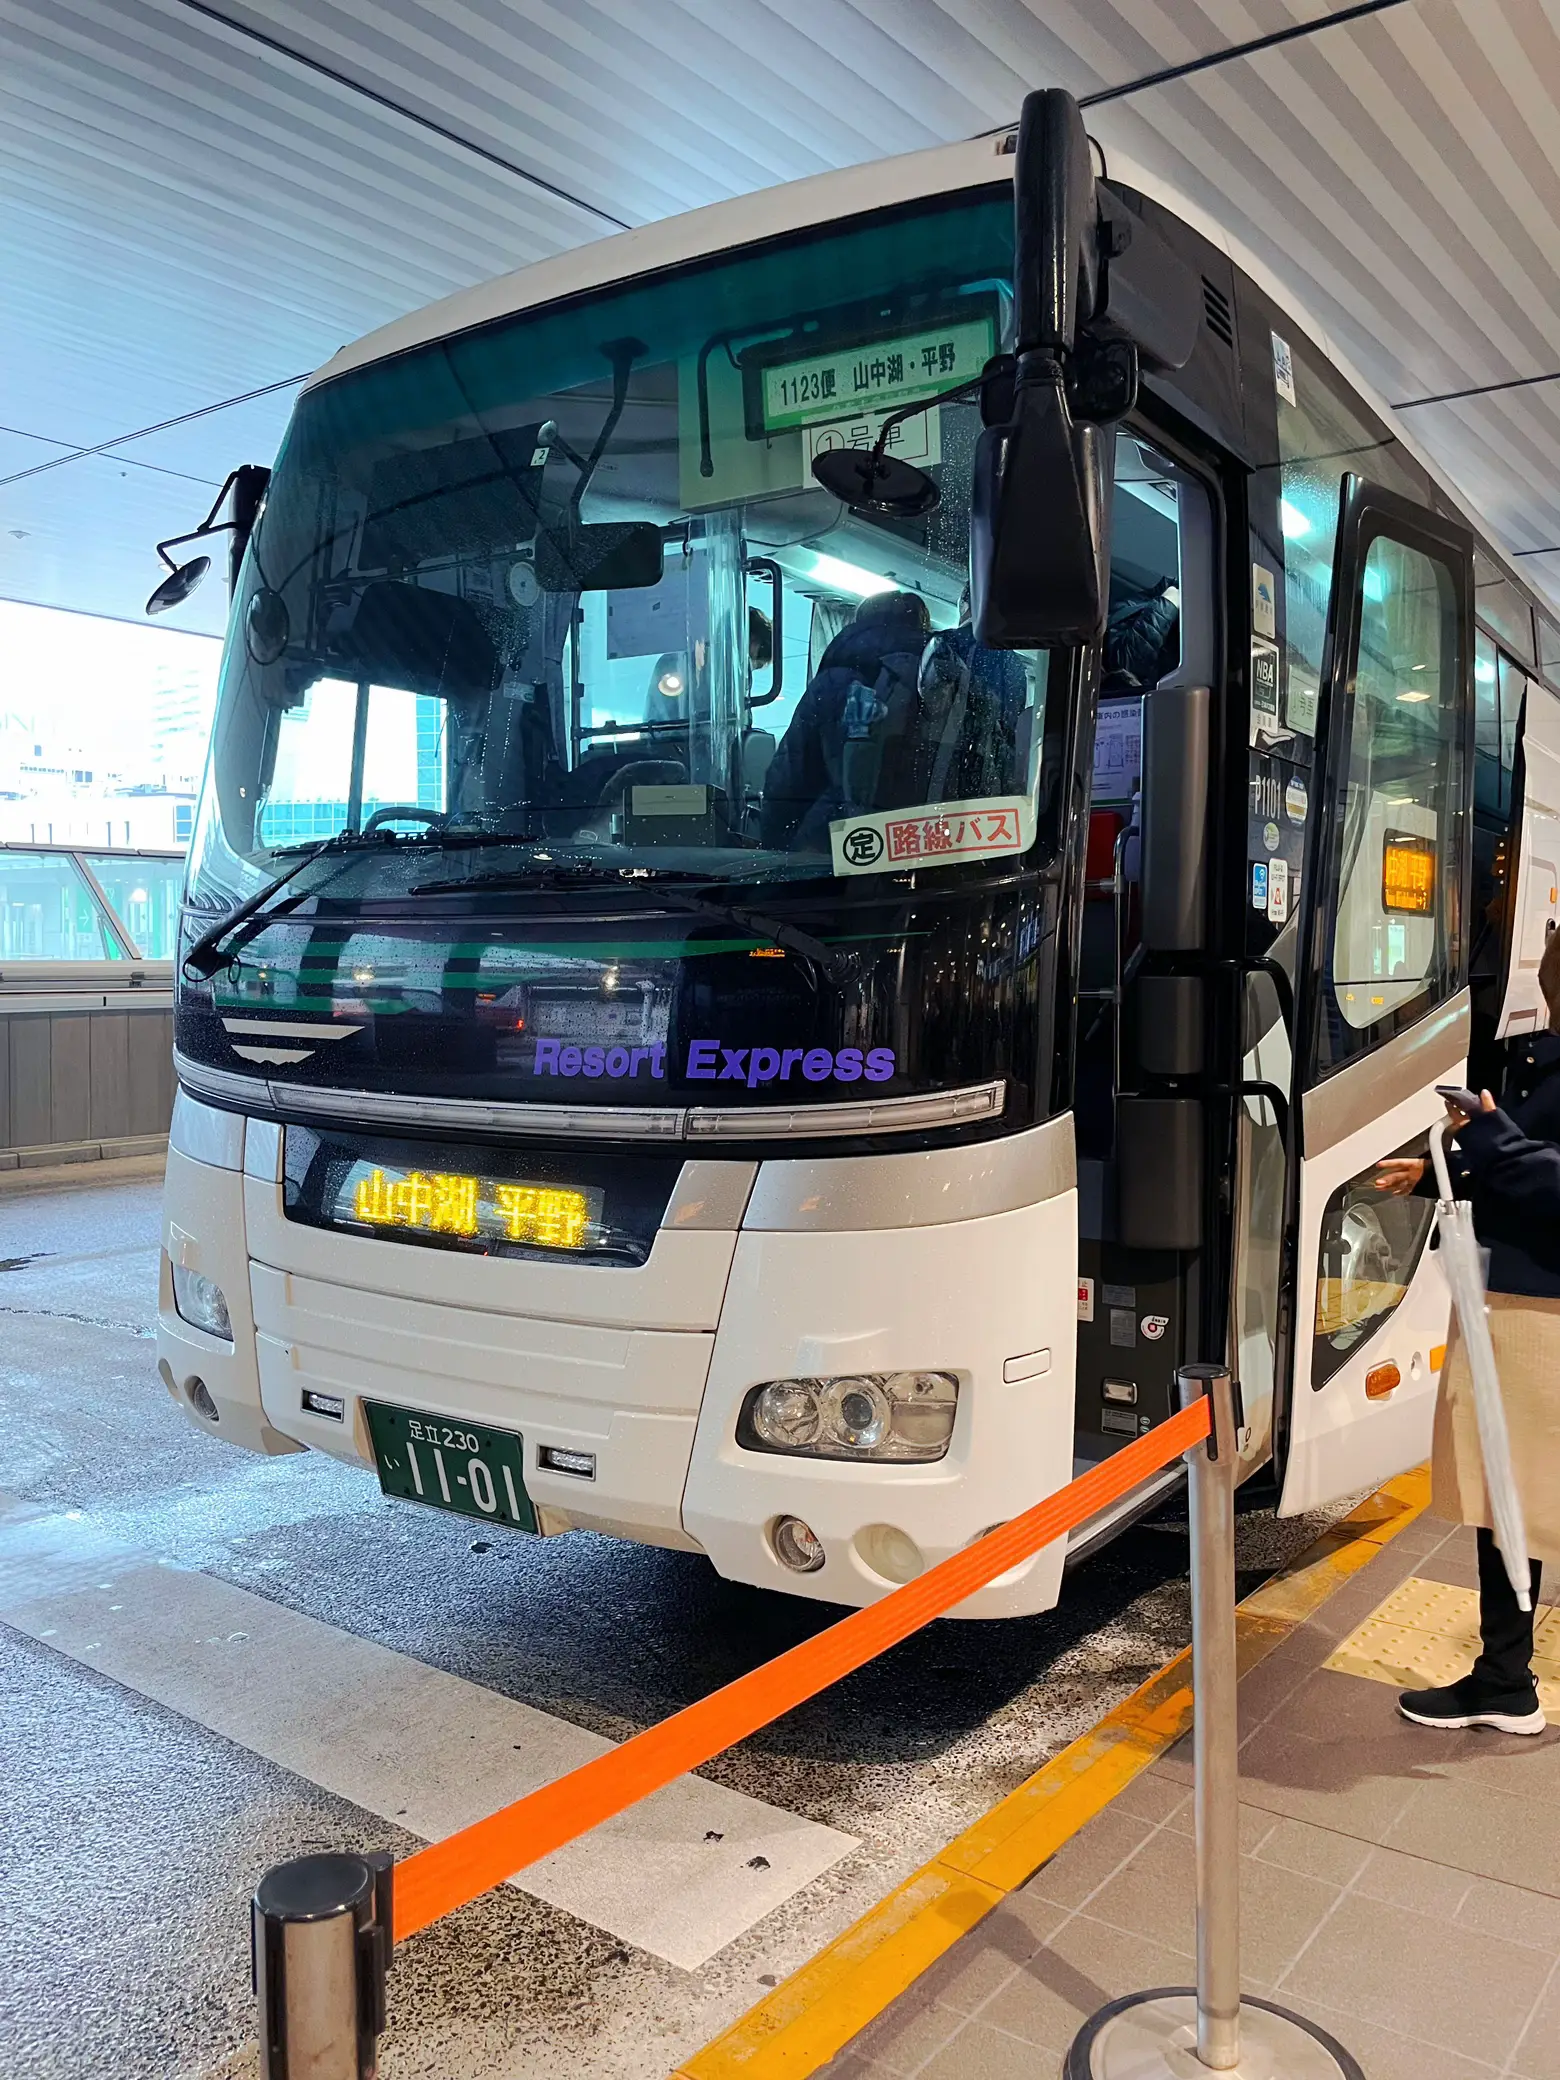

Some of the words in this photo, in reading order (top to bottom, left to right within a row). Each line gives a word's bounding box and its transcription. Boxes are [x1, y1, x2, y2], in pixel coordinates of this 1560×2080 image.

[781, 368, 837, 405] 1123便
[853, 342, 956, 391] 山中湖・平野
[1254, 775, 1281, 819] P1101
[892, 815, 1012, 856] 路線バス
[533, 1038, 667, 1079] Resort
[685, 1039, 895, 1088] Express
[356, 1169, 479, 1237] 山中湖
[493, 1184, 588, 1247] 平野
[406, 1441, 521, 1521] 11-01
